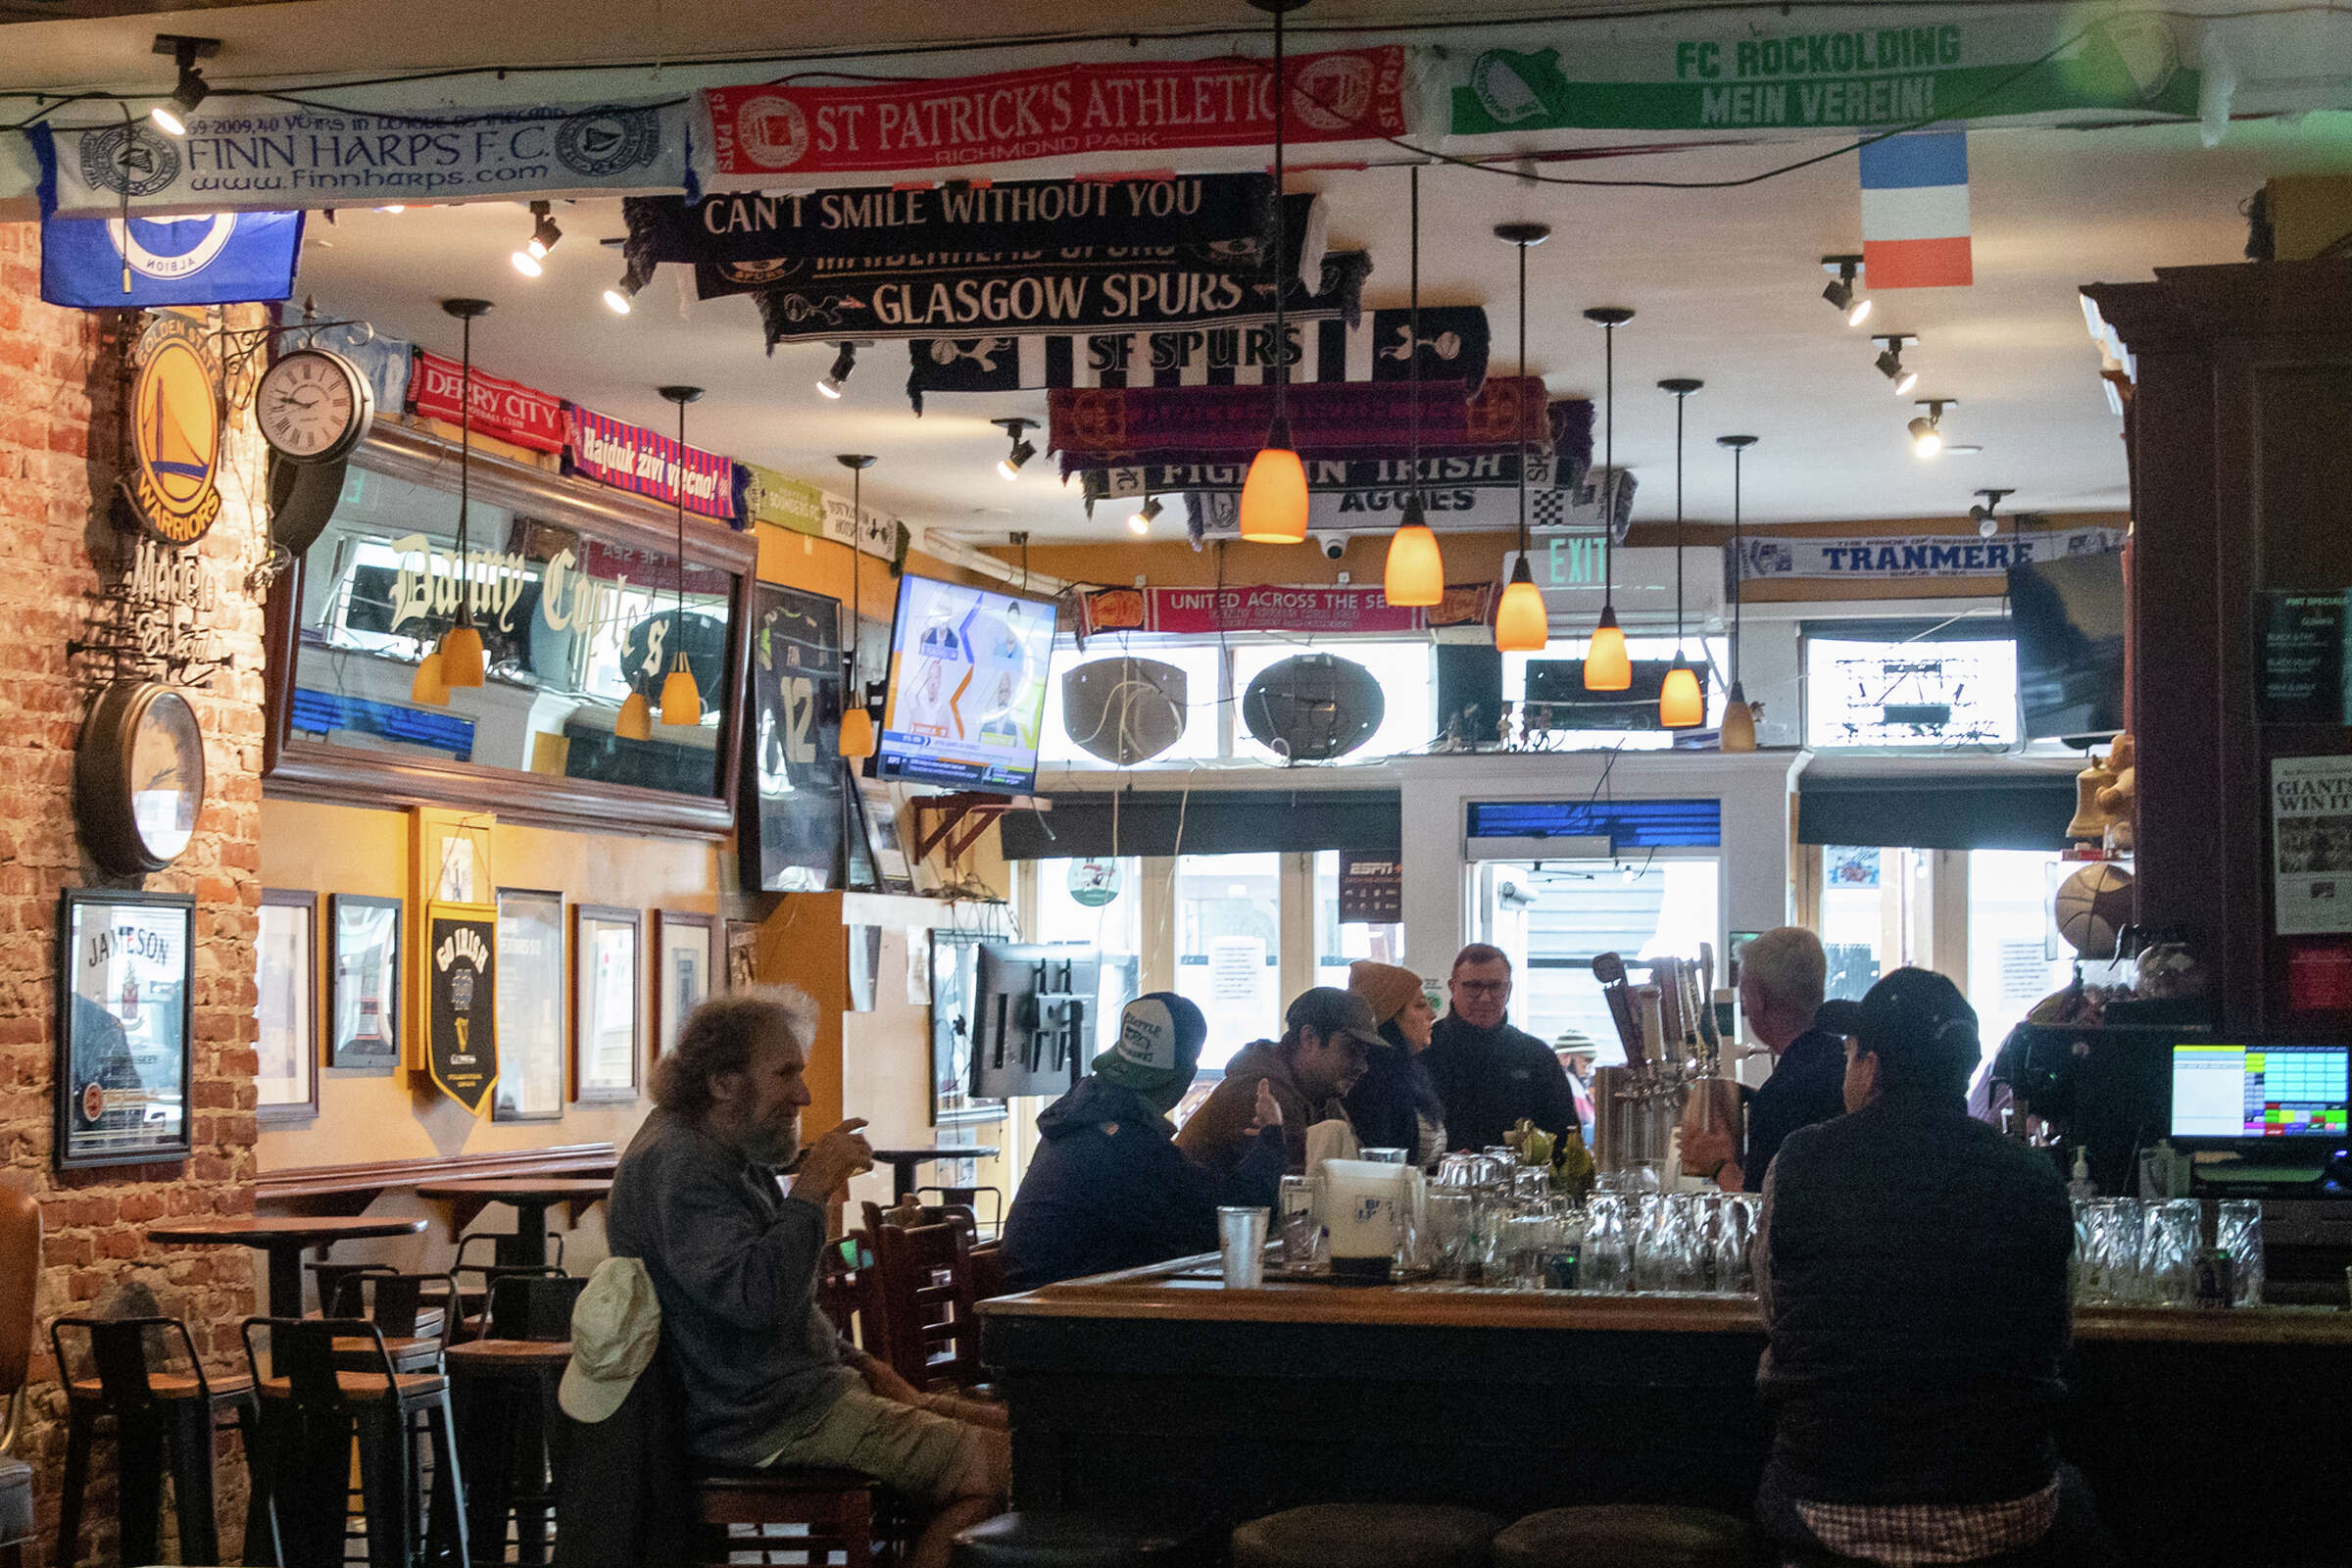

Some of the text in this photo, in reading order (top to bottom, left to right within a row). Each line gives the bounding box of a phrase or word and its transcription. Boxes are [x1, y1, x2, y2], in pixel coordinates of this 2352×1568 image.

[1677, 24, 1961, 79] FC ROCKOLDING
[816, 72, 1283, 153] ST PATRICK'S ATHLETIC
[1701, 75, 1936, 126] MEIN VEREIN!
[187, 125, 550, 171] FINN HARPS F.C.
[934, 132, 1159, 166] RICHMOND PARK
[704, 179, 1202, 236] CAN'T SMILE WITHOUT YOU
[872, 270, 1243, 325] GLASGOW SPURS
[139, 318, 185, 366] GOLDEN
[1087, 324, 1304, 371] SF SPURS
[425, 367, 501, 414] DERRY
[505, 394, 559, 430] CITY
[582, 424, 637, 478] Hajduk
[637, 447, 665, 484] živi
[1376, 454, 1502, 482] IRISH
[138, 474, 220, 541] WARRIORS
[1550, 537, 1608, 583] EXIT
[1822, 541, 2034, 571] TRANMERE
[389, 532, 526, 633] Danny
[1170, 591, 1392, 610] UNITED ACROSS THE SE
[780, 675, 817, 764] 12
[2279, 795, 2325, 811] WIN
[88, 925, 170, 967] JAMESON
[435, 935, 455, 972] GO
[454, 926, 490, 974] IRISH
